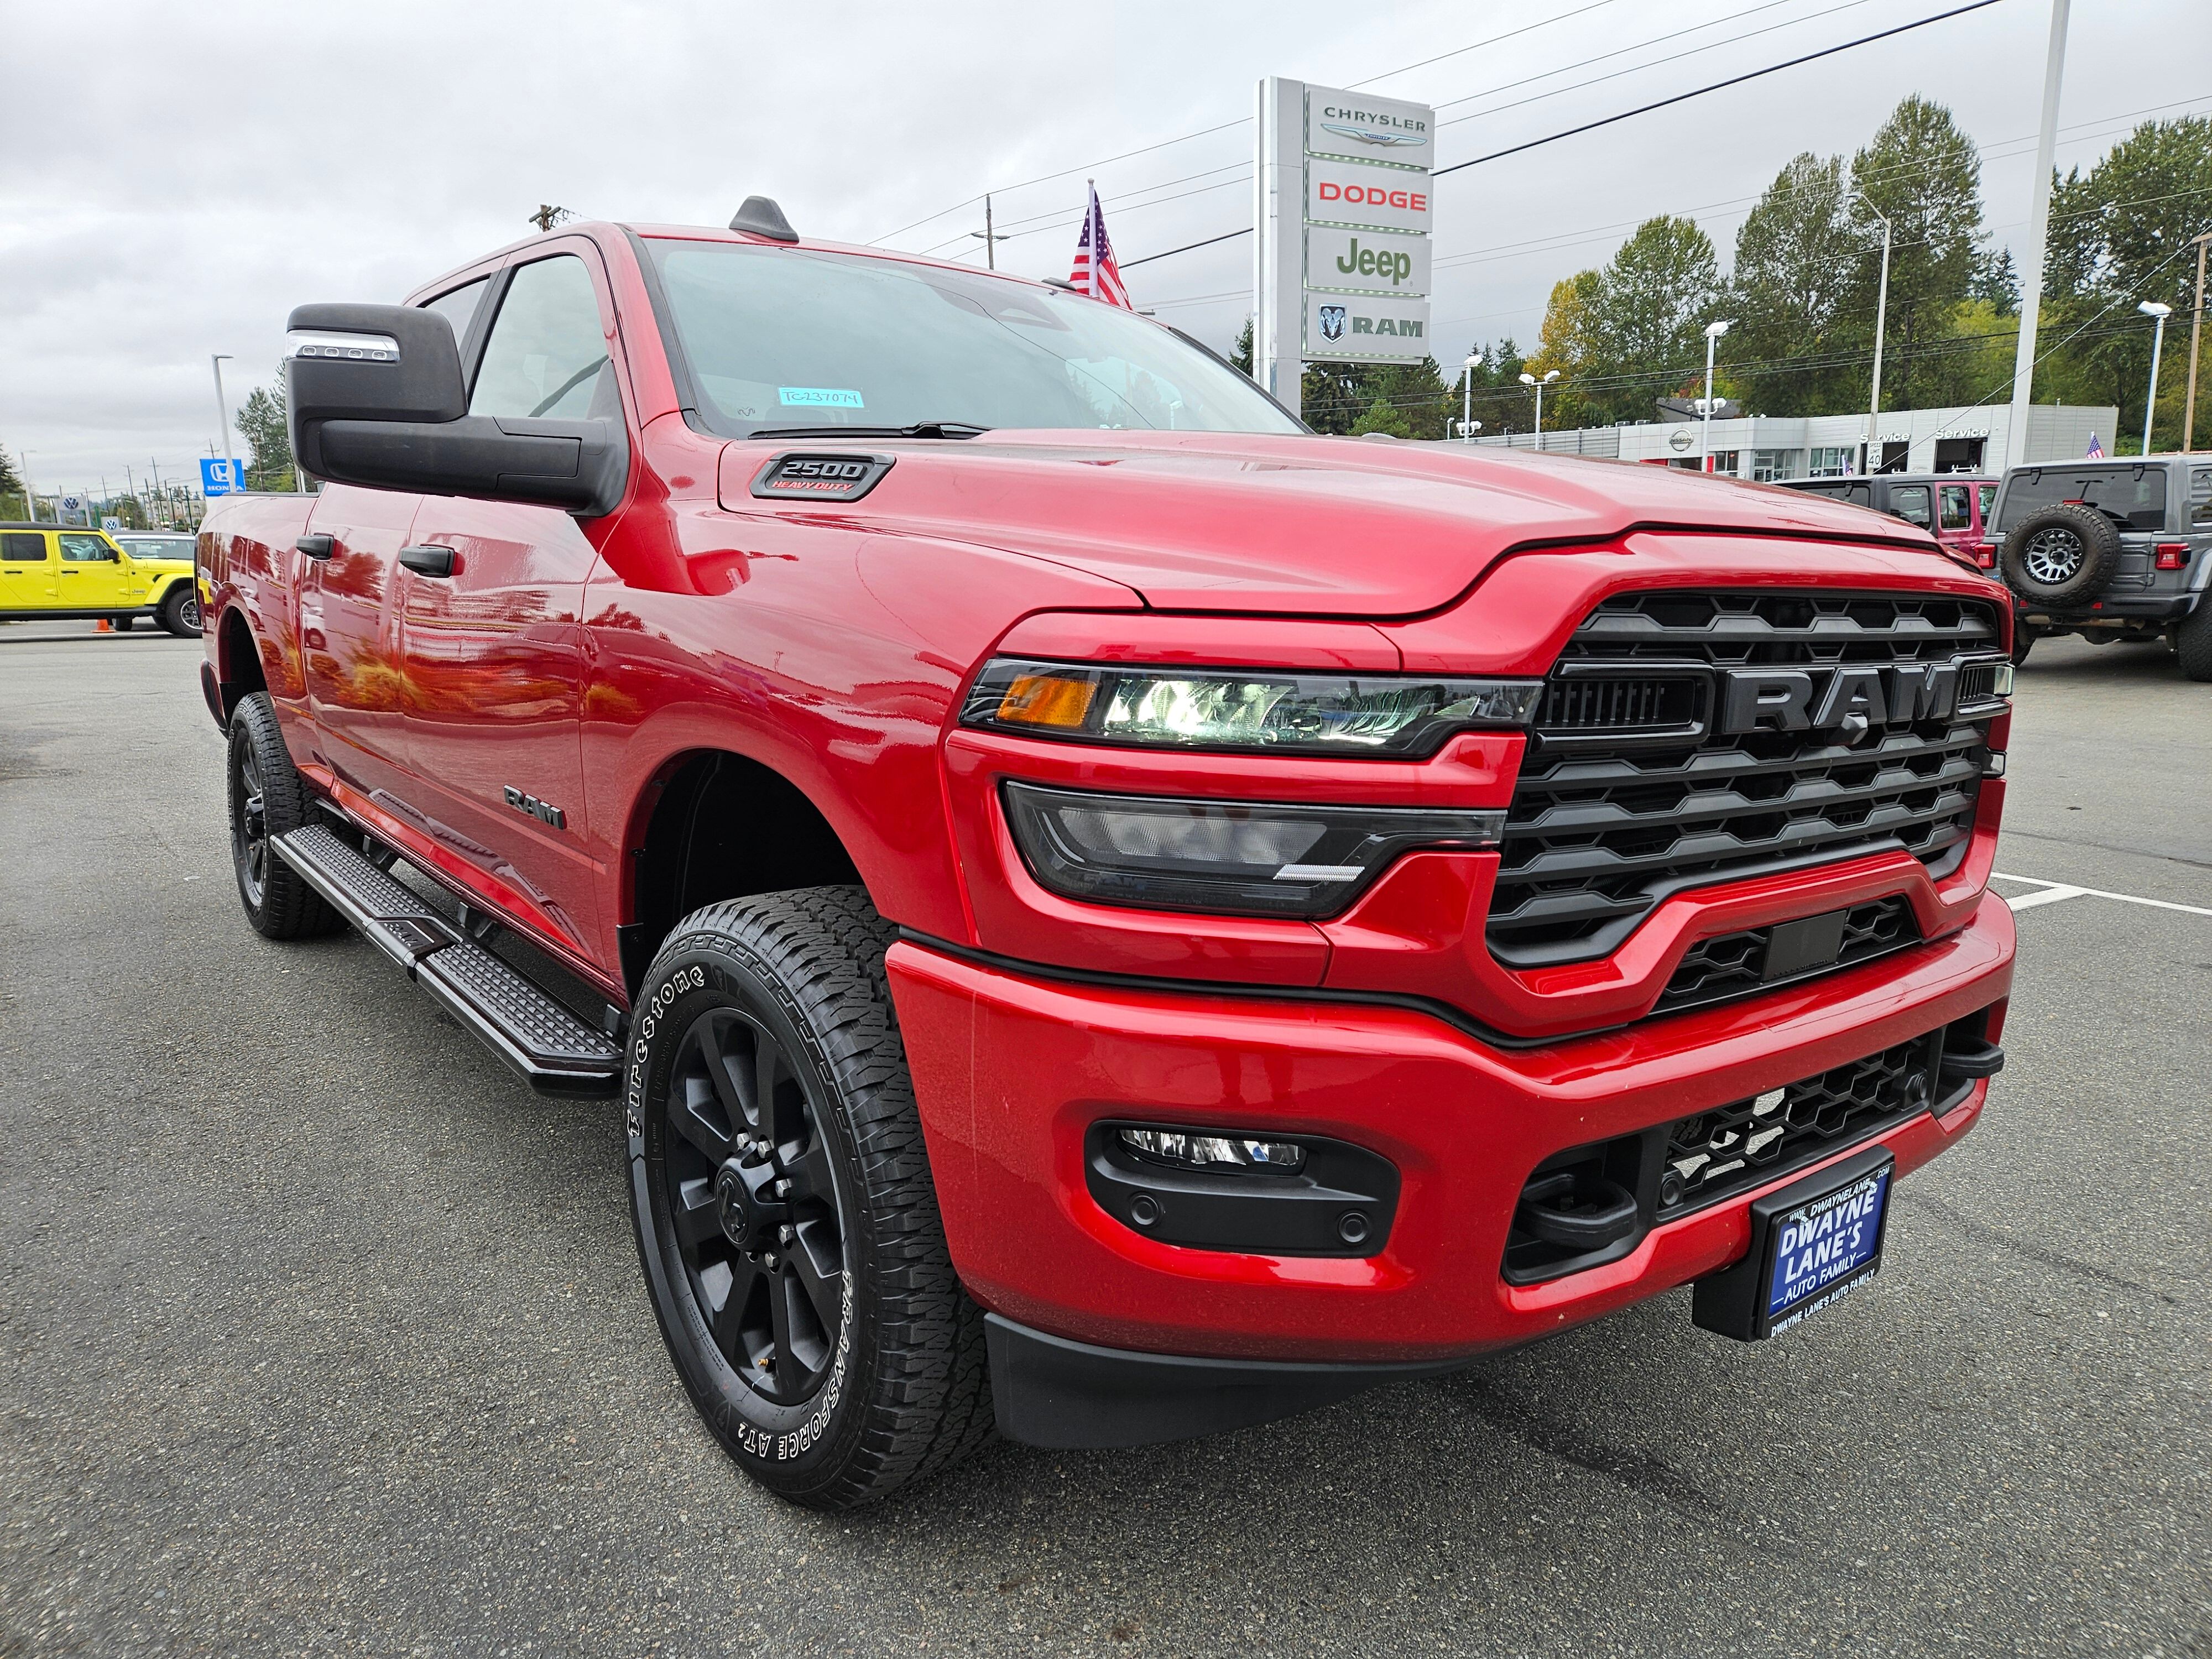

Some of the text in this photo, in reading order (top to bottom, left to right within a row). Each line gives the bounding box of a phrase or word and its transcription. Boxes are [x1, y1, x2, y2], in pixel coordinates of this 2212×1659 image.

[1324, 106, 1426, 133] CHRYSLER
[1319, 182, 1427, 211] DODGE
[1336, 238, 1411, 285] Jeep
[1353, 317, 1423, 338] RAM
[1860, 432, 1911, 444] Srvice
[1936, 427, 1989, 439] Service
[781, 462, 868, 481] 2500
[1869, 455, 1881, 465] 40
[771, 481, 855, 492] HEAVY DUTY
[1719, 663, 1957, 733] RAM
[503, 784, 565, 831] RAM
[627, 966, 705, 1138] Firestone
[1780, 1190, 1875, 1258] DWAYNE
[1785, 1220, 1863, 1284] LANE'S
[1783, 1251, 1857, 1305] AUTO FAMILY
[1771, 1267, 1875, 1338] DWAYNE LANE'S AUTO FAMILY
